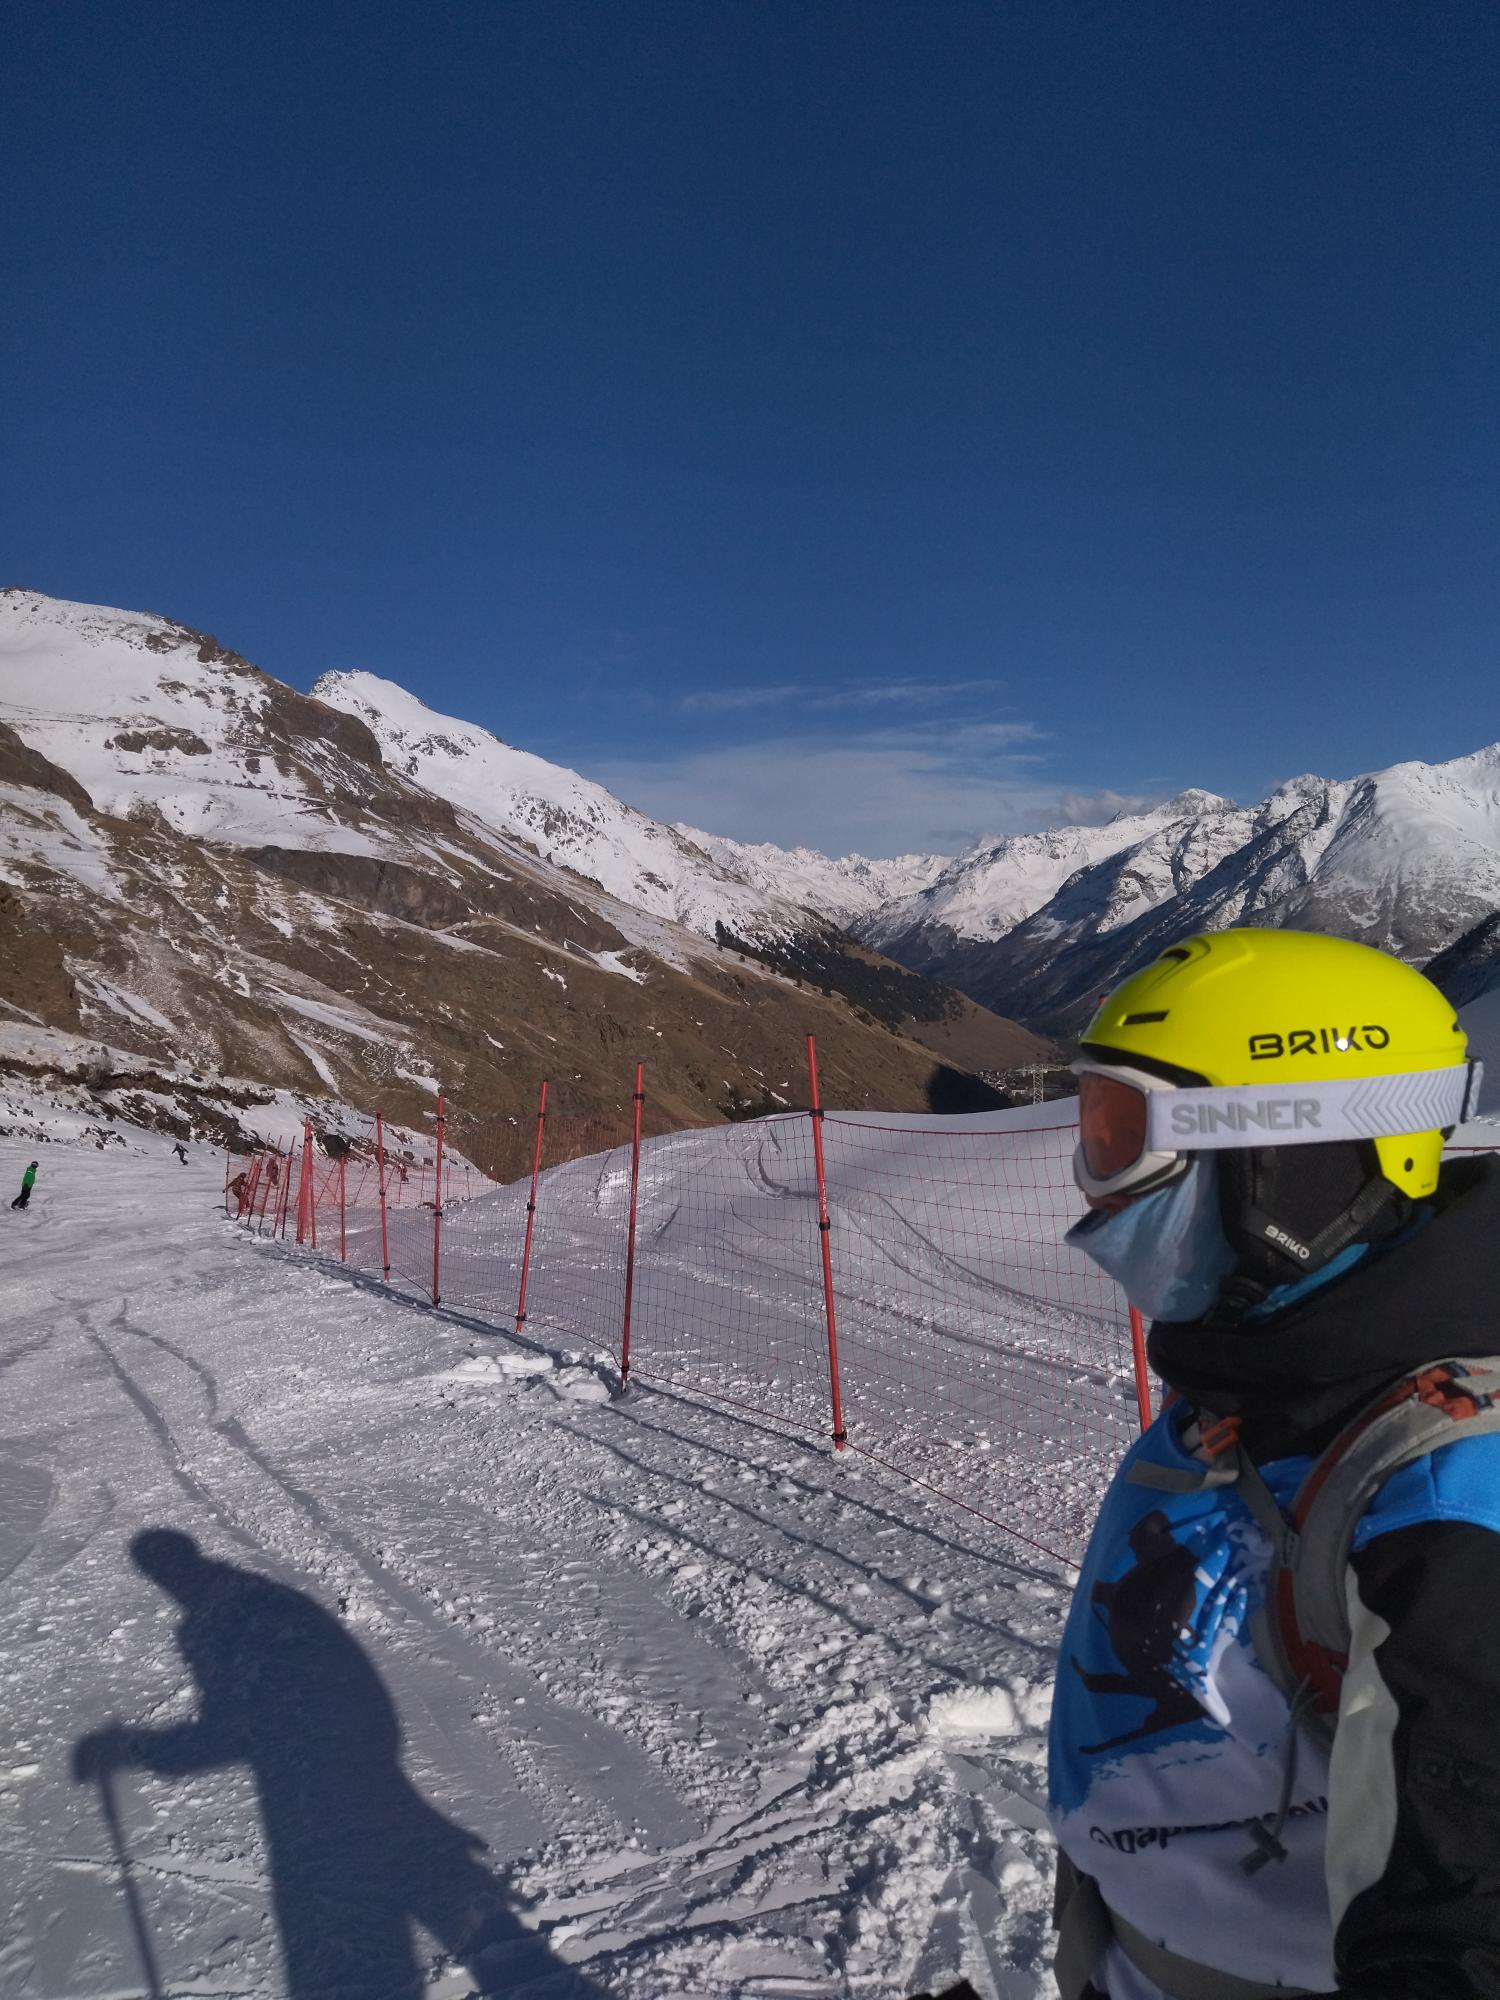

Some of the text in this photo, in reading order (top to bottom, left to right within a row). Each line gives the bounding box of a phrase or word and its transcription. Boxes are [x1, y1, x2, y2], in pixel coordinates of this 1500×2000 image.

[1249, 1025, 1390, 1060] BRIKO
[1171, 1098, 1321, 1135] SINNER
[1265, 1225, 1310, 1259] BRIKO
